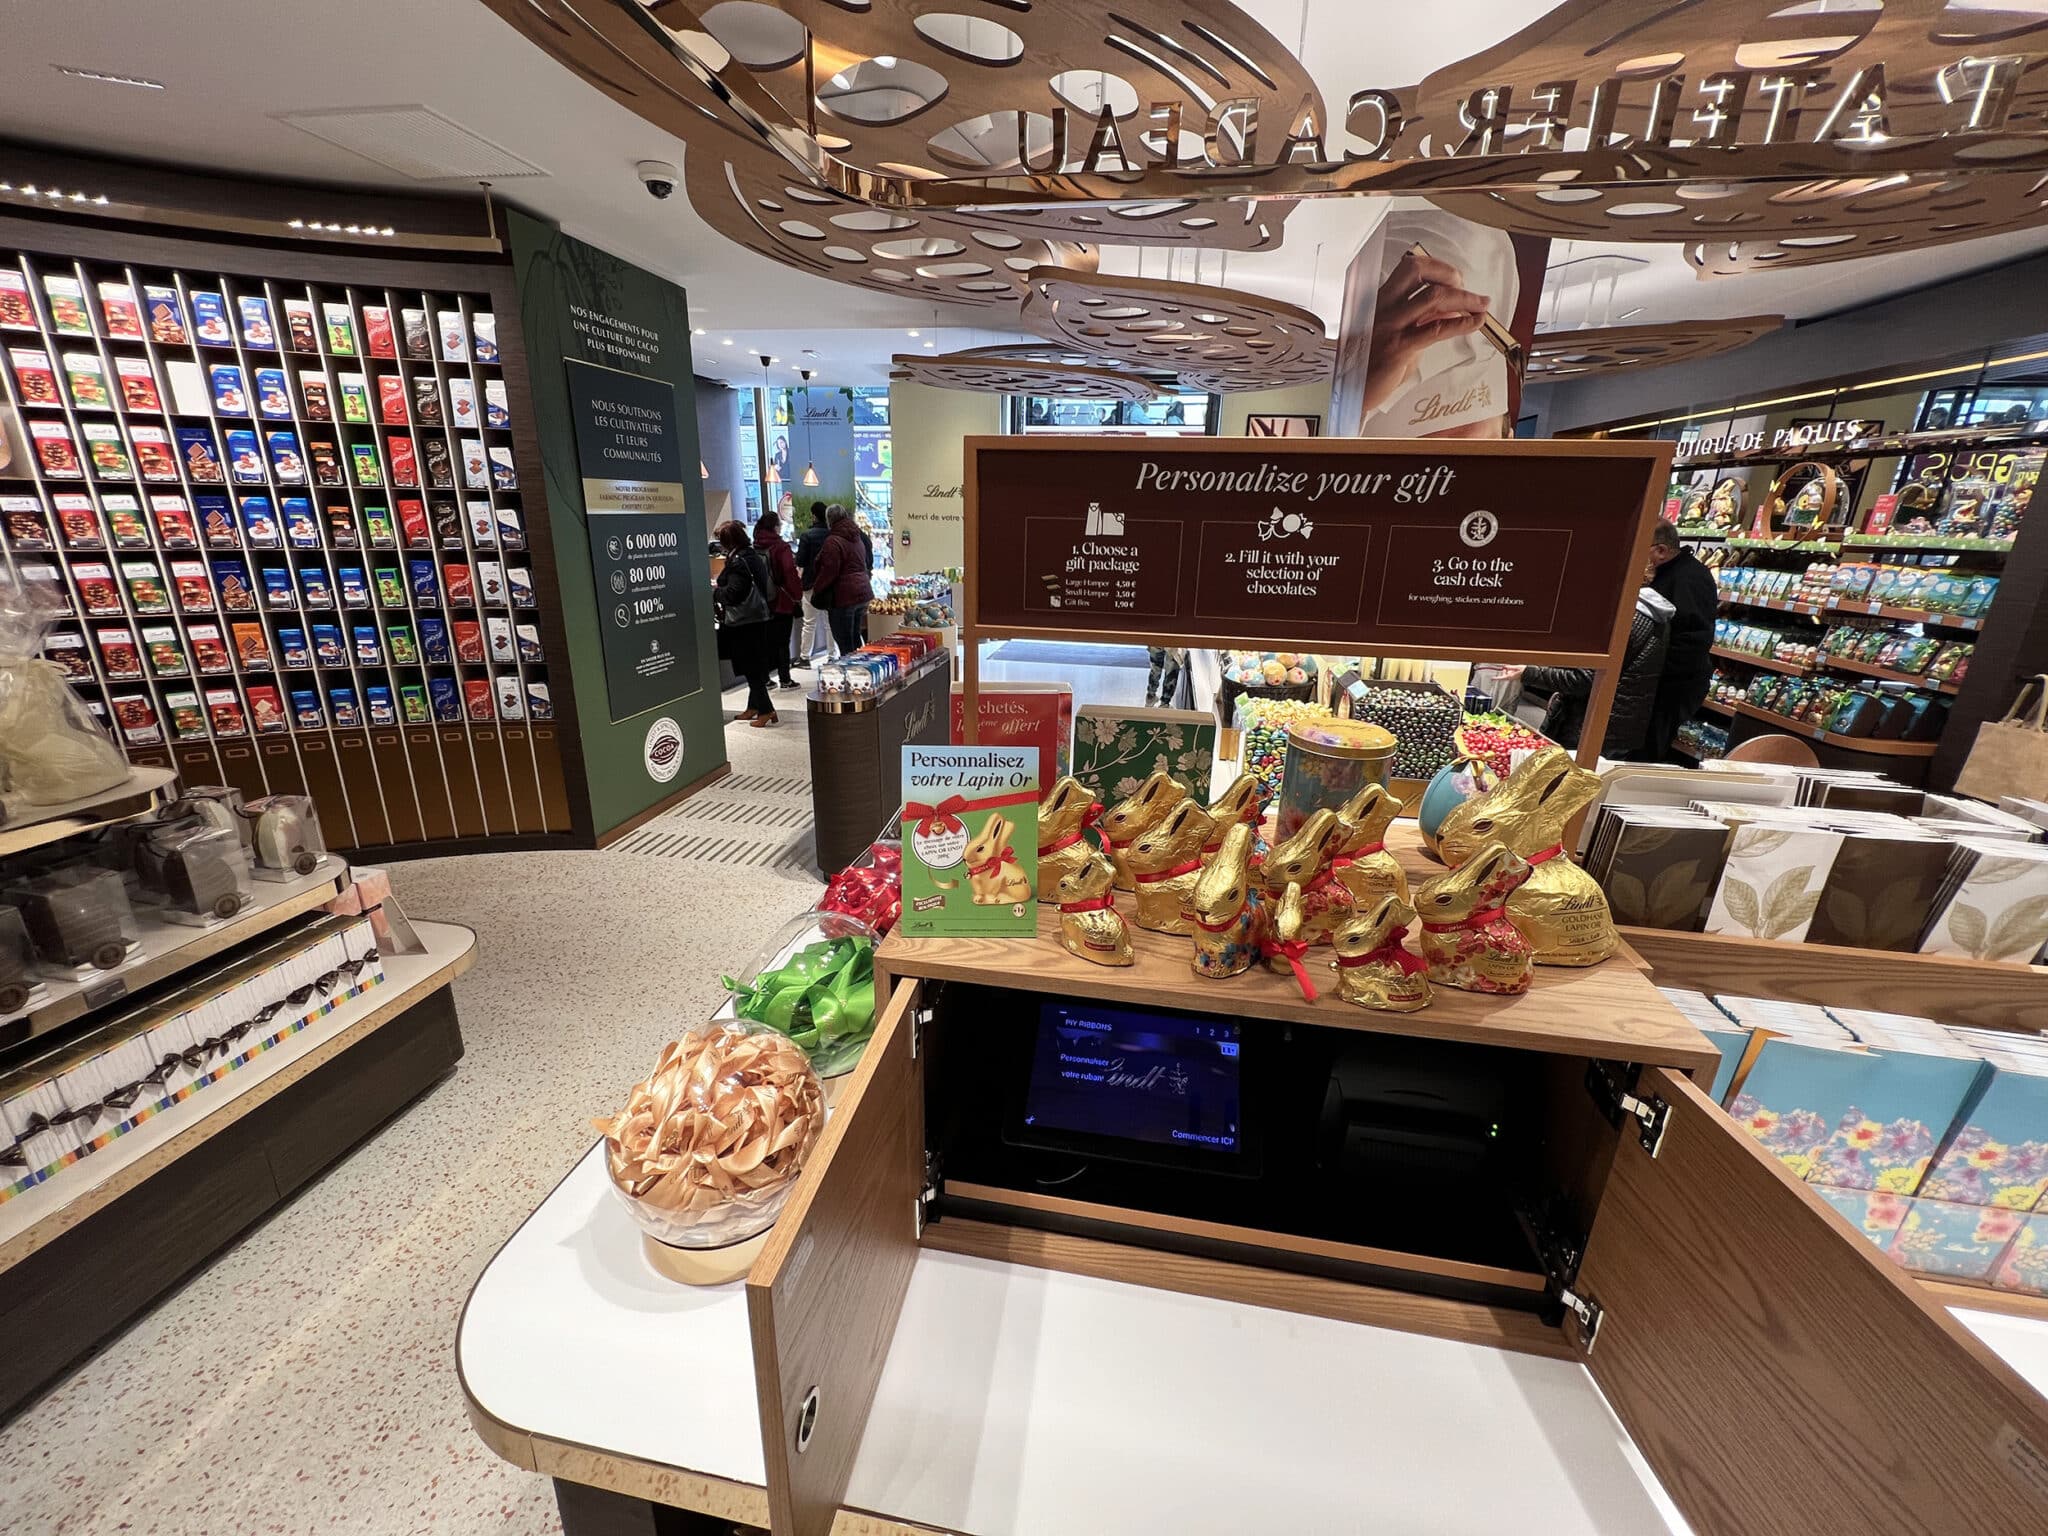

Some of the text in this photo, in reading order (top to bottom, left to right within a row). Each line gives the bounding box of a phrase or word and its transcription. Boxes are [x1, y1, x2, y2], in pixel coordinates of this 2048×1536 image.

[570, 304, 659, 341] NOS ENGAGEMENTS POUR
[573, 319, 659, 354] UNE CULTURE DU CACAO
[587, 338, 651, 364] PLUS RESPONSABLE
[591, 399, 662, 421] NOUS SOUTENONS
[804, 407, 831, 418] Lindt
[1408, 391, 1474, 425] Lindt
[594, 415, 663, 435] LES CULTIVATEURS
[615, 433, 648, 448] ET LEURS
[1676, 435, 1737, 458] UTIQUE
[1740, 431, 1765, 452] DE
[603, 446, 663, 463] COMMUNAUTÉS
[1136, 462, 1456, 503] Personalize your gift
[923, 484, 958, 498] Lindt
[907, 513, 928, 521] Merci
[941, 514, 960, 522] votre
[626, 532, 678, 550] 6 000 000
[1072, 542, 1139, 557] 1. Choose a
[1065, 557, 1140, 574] gift package
[1225, 549, 1340, 570] 2. Fill it with your
[1432, 557, 1514, 573] 3. Go to the
[629, 565, 666, 583] 80 000
[1246, 566, 1323, 582] selection of
[1433, 572, 1503, 588] cash desk
[1065, 579, 1109, 588] Large Hamper
[1246, 581, 1317, 597] chocolates
[1065, 588, 1109, 598] Small Hamper
[1408, 593, 1419, 601] for
[1455, 595, 1481, 604] stickers
[1482, 596, 1496, 605] and
[1497, 596, 1525, 605] ribbons
[633, 597, 664, 616] 100%
[956, 701, 1029, 715] 3 chetés,
[902, 708, 930, 743] Lindt
[1001, 719, 1041, 735] offert
[654, 743, 674, 757] COCOA
[911, 752, 1025, 769] Personnalisez
[911, 772, 1033, 791] votre Lapin Or
[1559, 895, 1595, 911] Lindt
[1561, 912, 1604, 924] GOLDHASE
[1565, 921, 1602, 932] LAPIN OR
[1065, 1018, 1113, 1031] MY RIBBONS
[1060, 1053, 1109, 1067] Personnaliser
[1061, 1071, 1080, 1080] votre
[1172, 1129, 1220, 1144] Commencer
